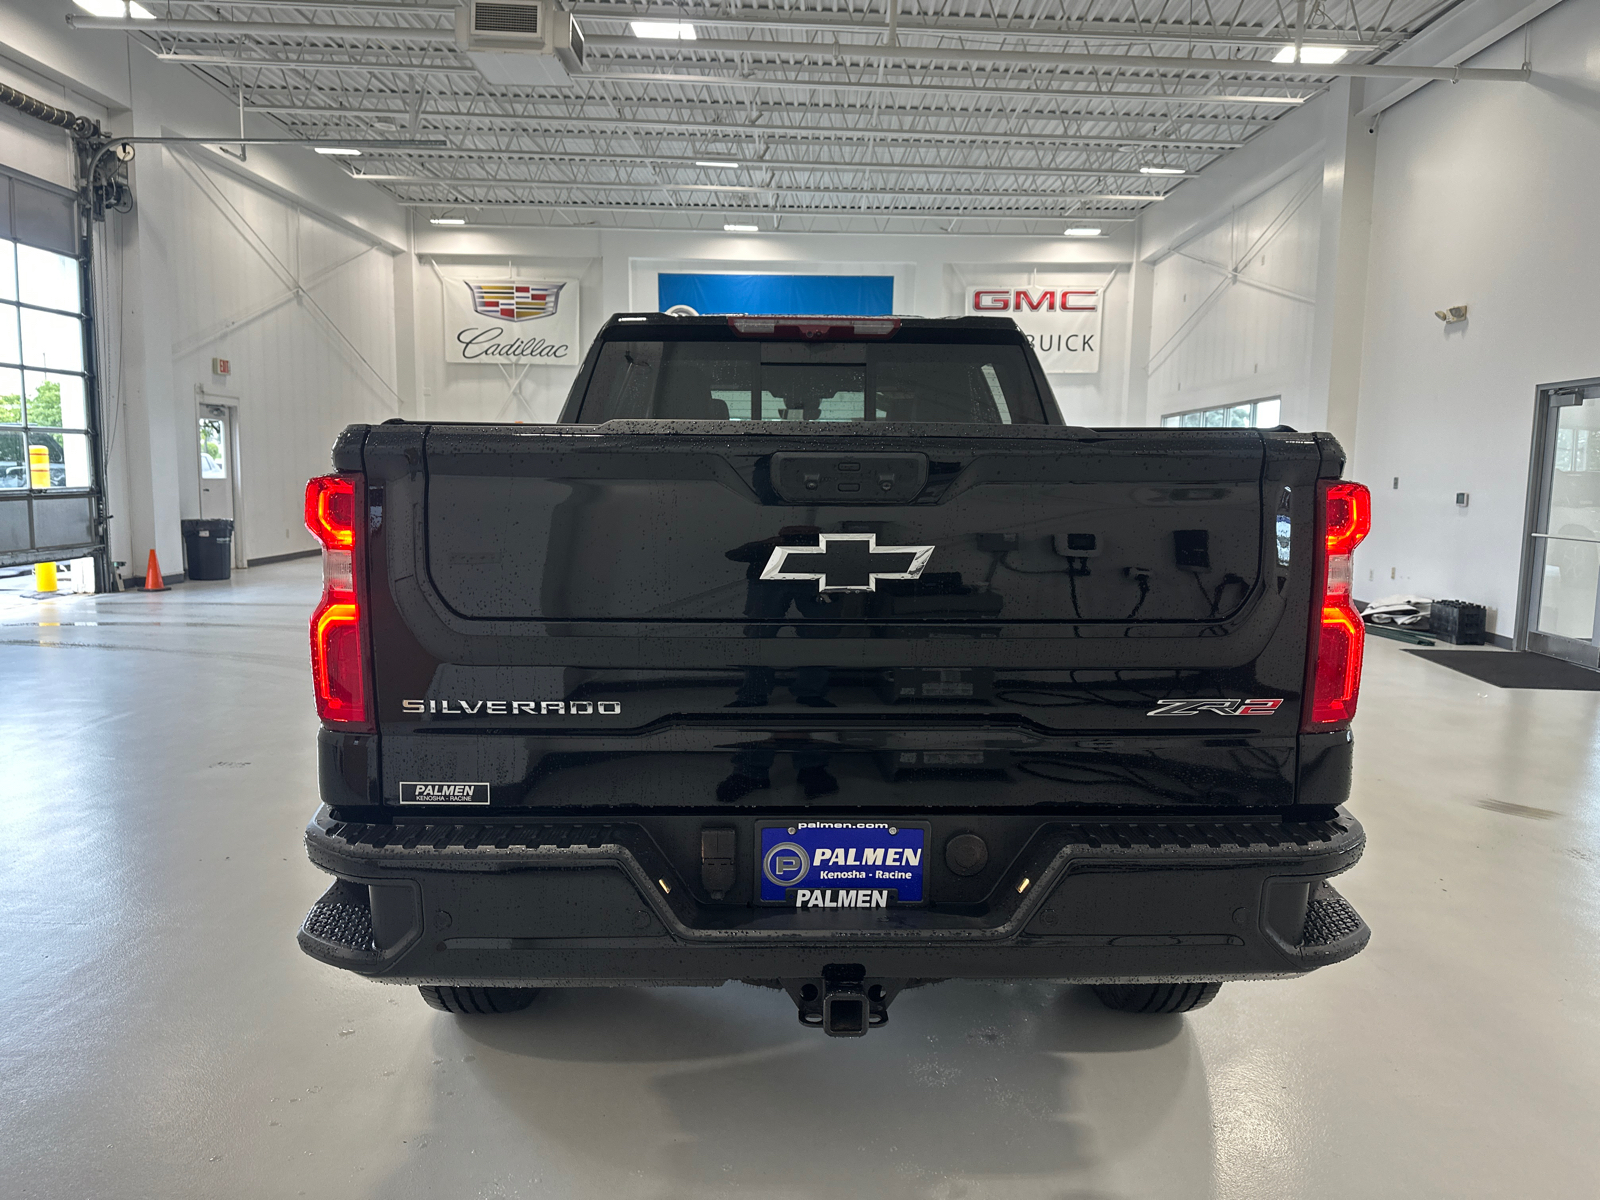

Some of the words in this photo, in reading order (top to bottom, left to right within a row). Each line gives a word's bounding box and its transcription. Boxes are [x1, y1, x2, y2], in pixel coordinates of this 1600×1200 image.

[973, 289, 1098, 312] GMC
[457, 327, 568, 359] Cadillac
[402, 699, 621, 715] SILVERADO
[1147, 699, 1284, 716] ZR2
[415, 785, 475, 796] PALMEN
[776, 856, 800, 875] P
[813, 848, 922, 866] PALMEN
[820, 870, 866, 879] Kenosha
[875, 870, 912, 880] Racine
[796, 889, 888, 908] PALMEN
